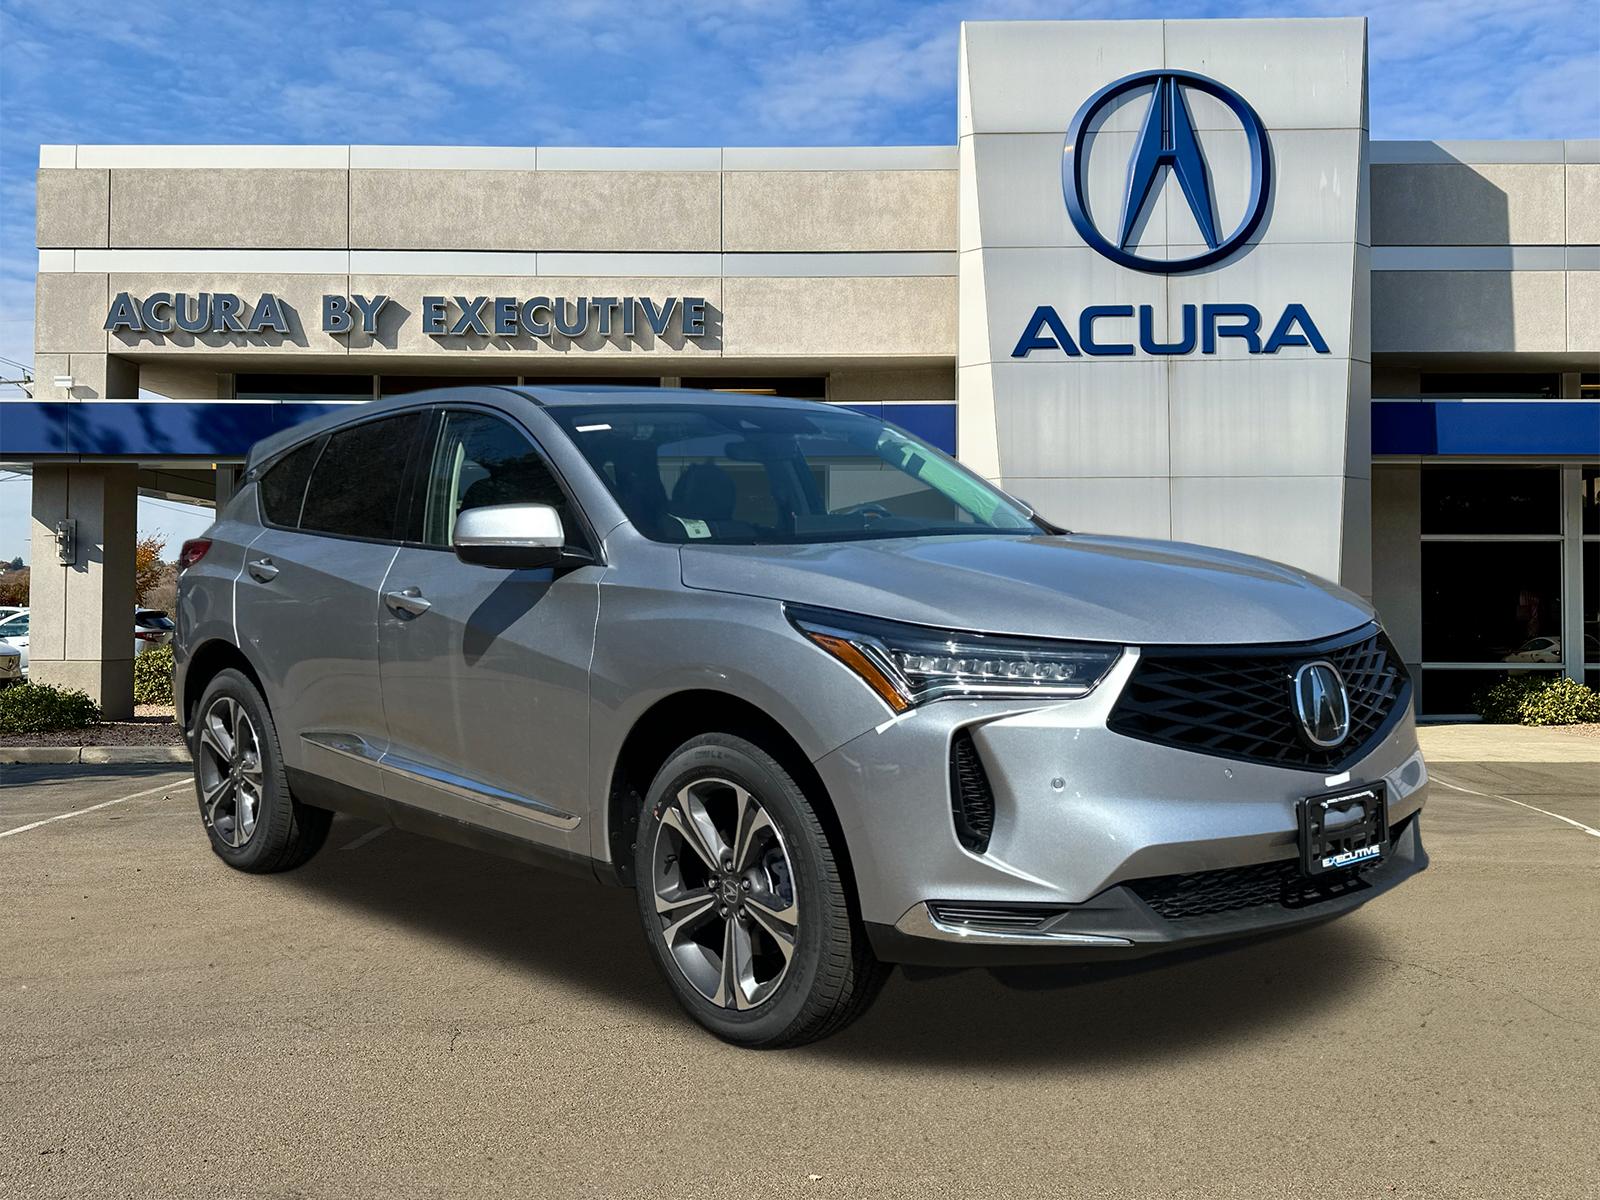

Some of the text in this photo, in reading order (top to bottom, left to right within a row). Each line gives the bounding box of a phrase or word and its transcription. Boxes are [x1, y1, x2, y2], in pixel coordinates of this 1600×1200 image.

[103, 292, 706, 337] ACURA BY EXECUTIVE
[1010, 303, 1332, 357] ACURA
[1322, 844, 1380, 868] EXECUTIVE
